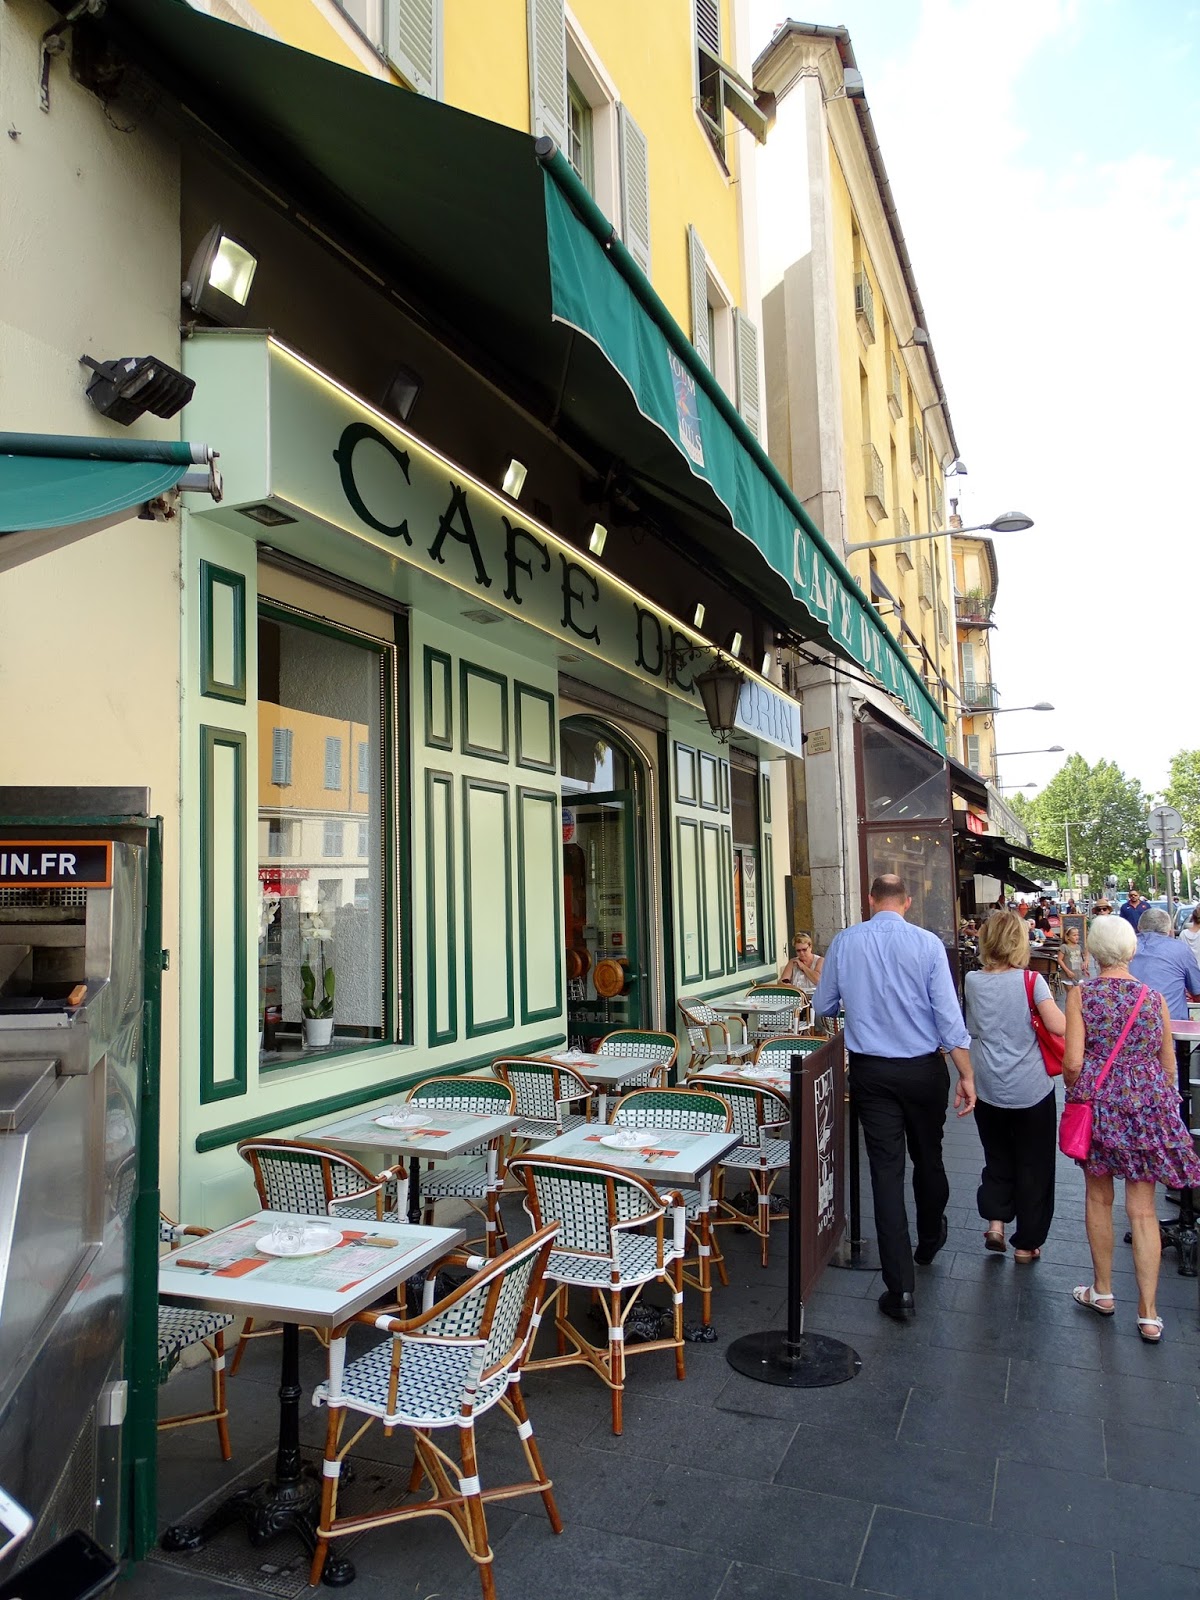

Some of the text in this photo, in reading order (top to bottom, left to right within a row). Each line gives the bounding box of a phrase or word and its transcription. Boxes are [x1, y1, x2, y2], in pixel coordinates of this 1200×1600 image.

[333, 422, 600, 645] CAFE
[633, 602, 696, 696] DE
[739, 678, 795, 749] URIN
[793, 528, 853, 646] CAFE
[0, 853, 77, 875] IN.FR
